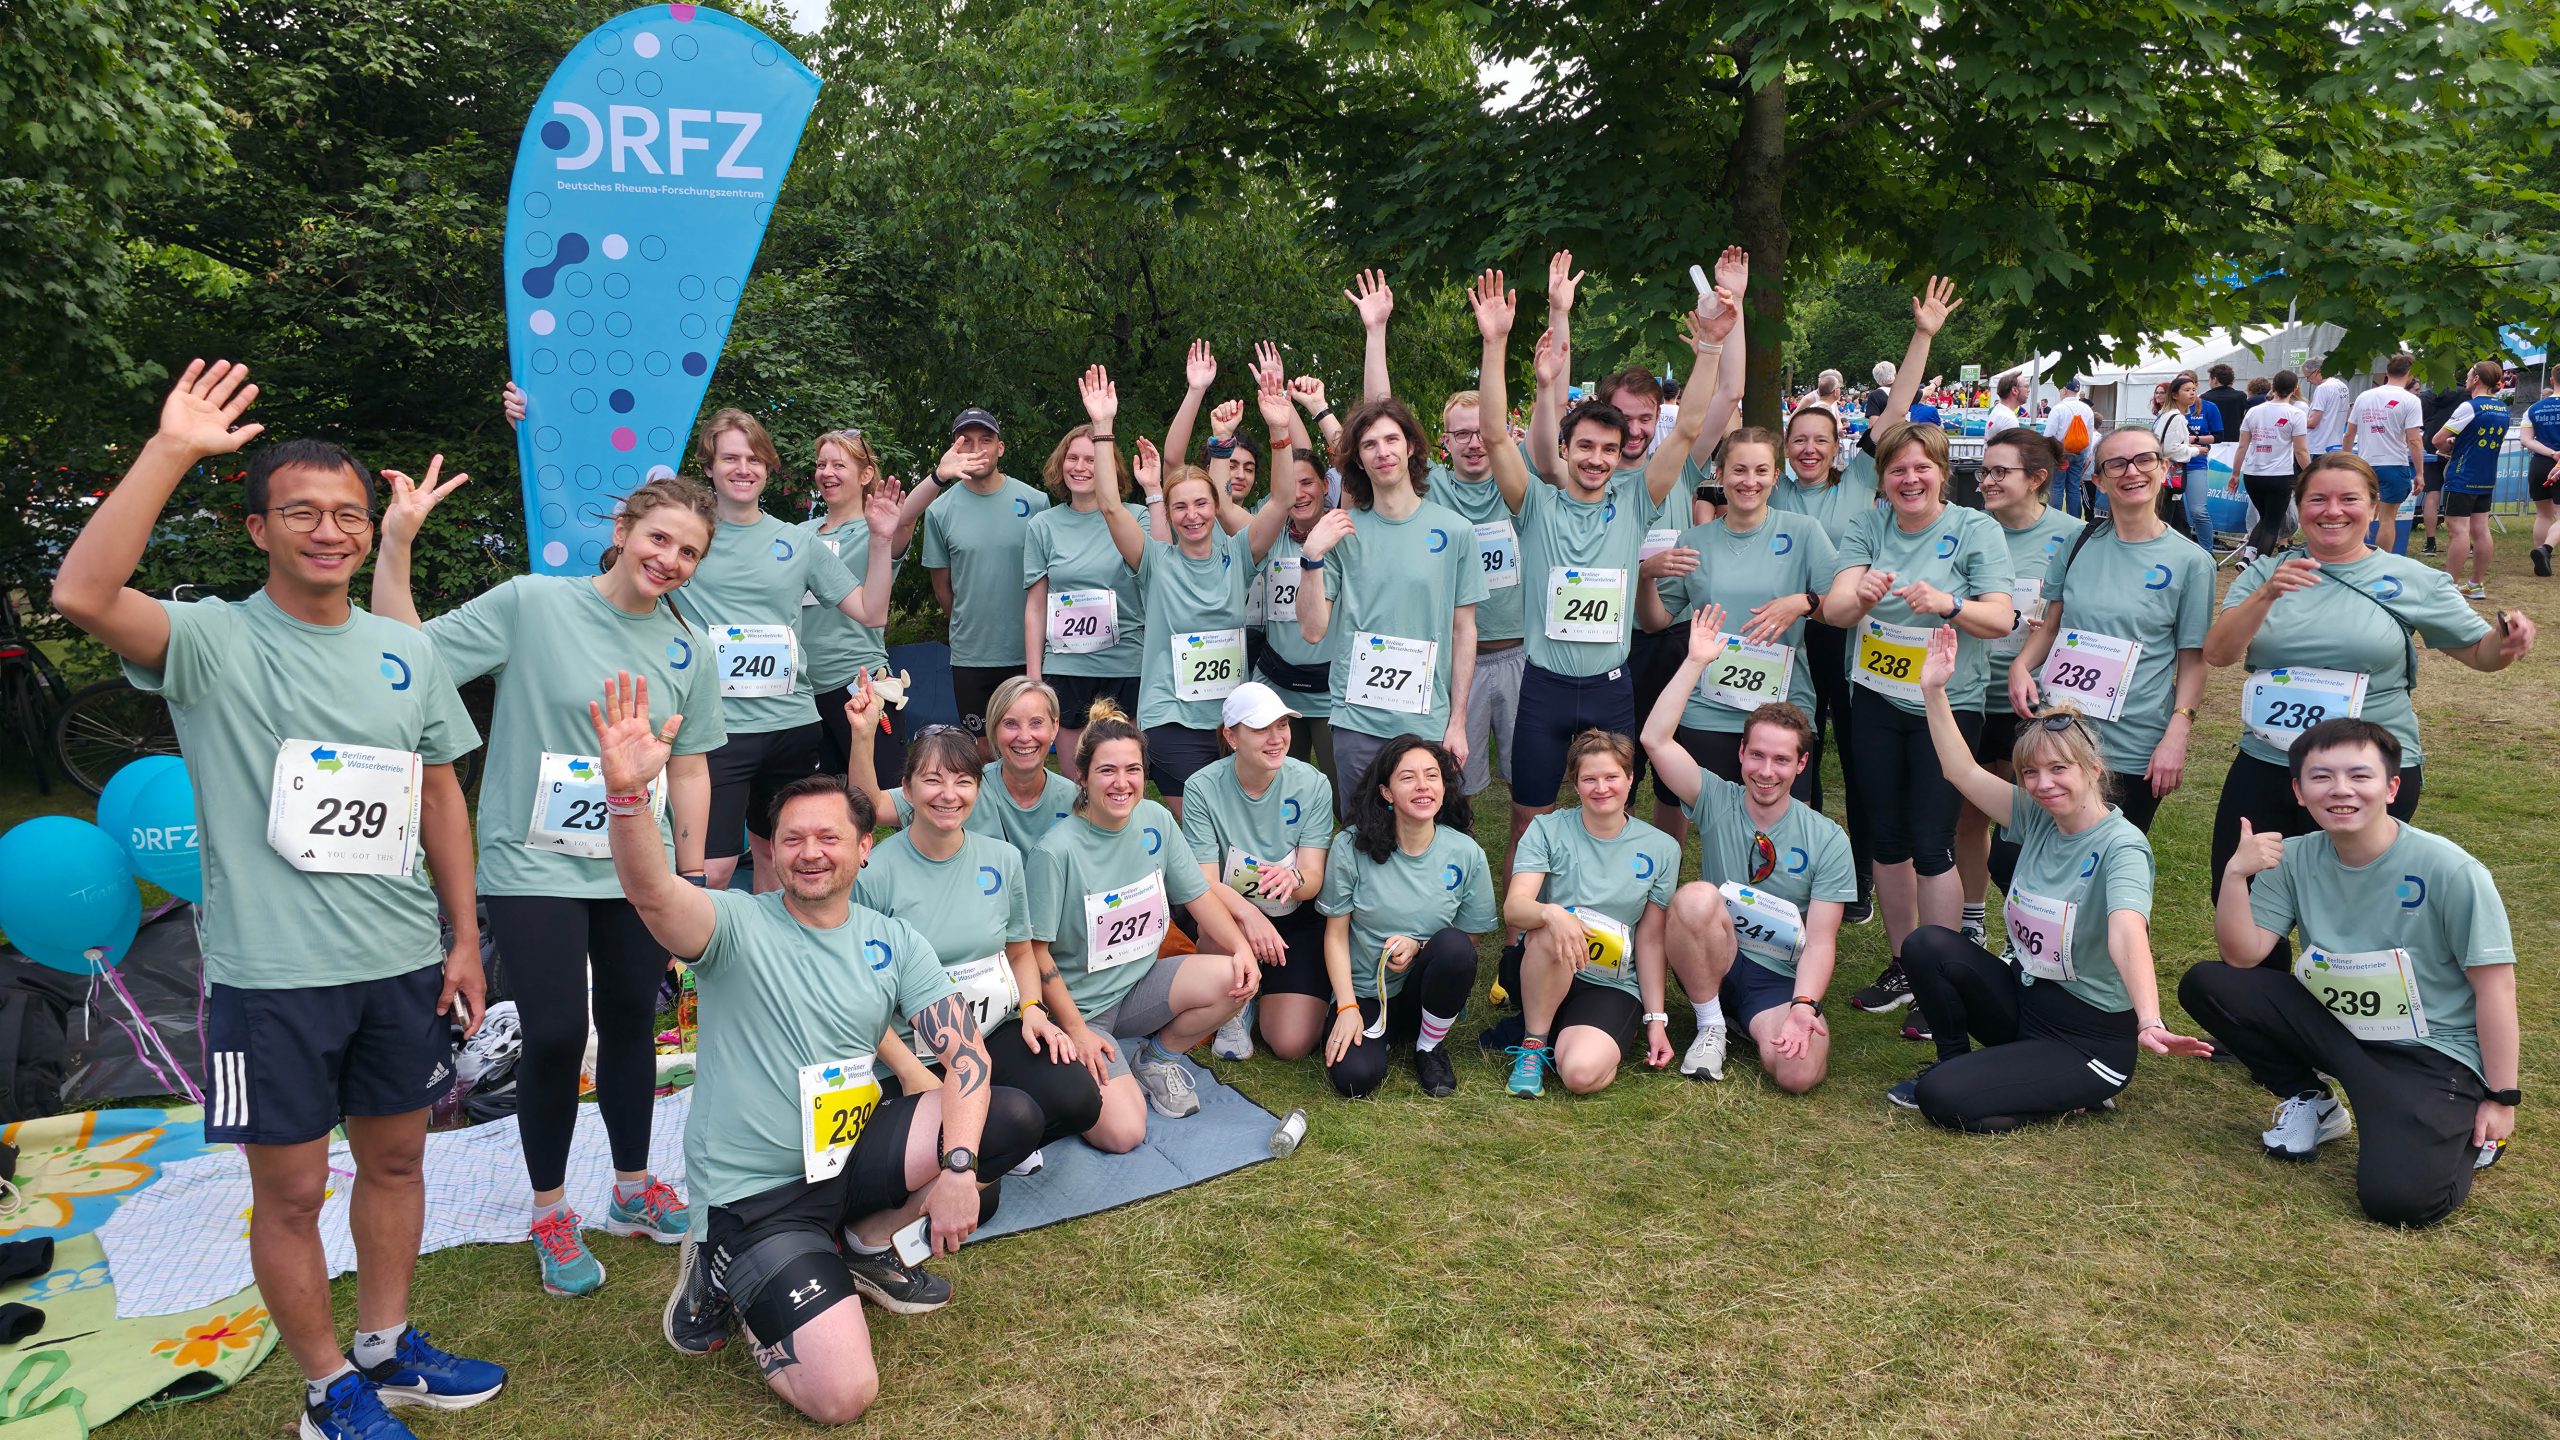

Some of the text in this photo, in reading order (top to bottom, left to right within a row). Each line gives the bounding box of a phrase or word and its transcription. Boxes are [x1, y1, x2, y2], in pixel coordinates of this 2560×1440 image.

[541, 101, 763, 179] DRFZ
[557, 180, 764, 199] Deutsches Rheuma-Forschungszentrum
[1481, 549, 1503, 572] 39
[1510, 559, 1515, 567] 5
[1274, 585, 1300, 605] 23
[1556, 586, 1562, 596] C
[1055, 610, 1060, 618] C
[1564, 599, 1608, 622] 240
[1614, 613, 1618, 622] 2
[1063, 616, 1097, 637] 240
[1105, 625, 1111, 634] 3
[1863, 635, 1868, 643] C
[719, 645, 725, 653] C
[2054, 648, 2060, 658] C
[1181, 652, 1187, 660] C
[1360, 652, 1366, 661] C
[730, 655, 776, 677] 240
[1193, 658, 1231, 682] 236
[1867, 650, 1912, 679] 238
[783, 668, 789, 677] 5
[1237, 669, 1241, 677] 2
[1366, 665, 1413, 691] 237
[1718, 665, 1766, 691] 238
[2052, 662, 2101, 691] 238
[2291, 670, 2317, 678] Berliner
[2294, 676, 2345, 687] Wasserbetriebe
[1418, 684, 1422, 693] 1
[1771, 686, 1778, 696] 2
[2106, 686, 2115, 698] 3
[2255, 685, 2263, 696] C
[2265, 701, 2326, 730] 238
[342, 751, 375, 761] Berliner
[347, 760, 404, 773] Wasserbetriebe
[293, 776, 304, 791] C
[553, 782, 562, 794] C
[309, 797, 388, 839] 239
[561, 800, 609, 831] 23
[131, 824, 199, 850] DRFZ
[398, 825, 404, 841] 1
[327, 851, 394, 862] YOU GOT THIS
[1234, 868, 1240, 877] C
[1097, 915, 1103, 925] C
[1158, 919, 1163, 929] 3
[1107, 911, 1151, 946] 237
[1734, 916, 1776, 942] 241
[2053, 951, 2060, 962] 3
[953, 967, 976, 977] Berliner
[2331, 962, 2387, 971] Wasserbetriebe
[2304, 969, 2312, 980] C
[2323, 987, 2381, 1017] 239
[1003, 1005, 1008, 1015] 1
[2397, 1004, 2408, 1015] 2
[844, 1064, 865, 1073] Berliner
[426, 1069, 449, 1089] adidas
[814, 1096, 822, 1110] C
[829, 1102, 872, 1145] 239
